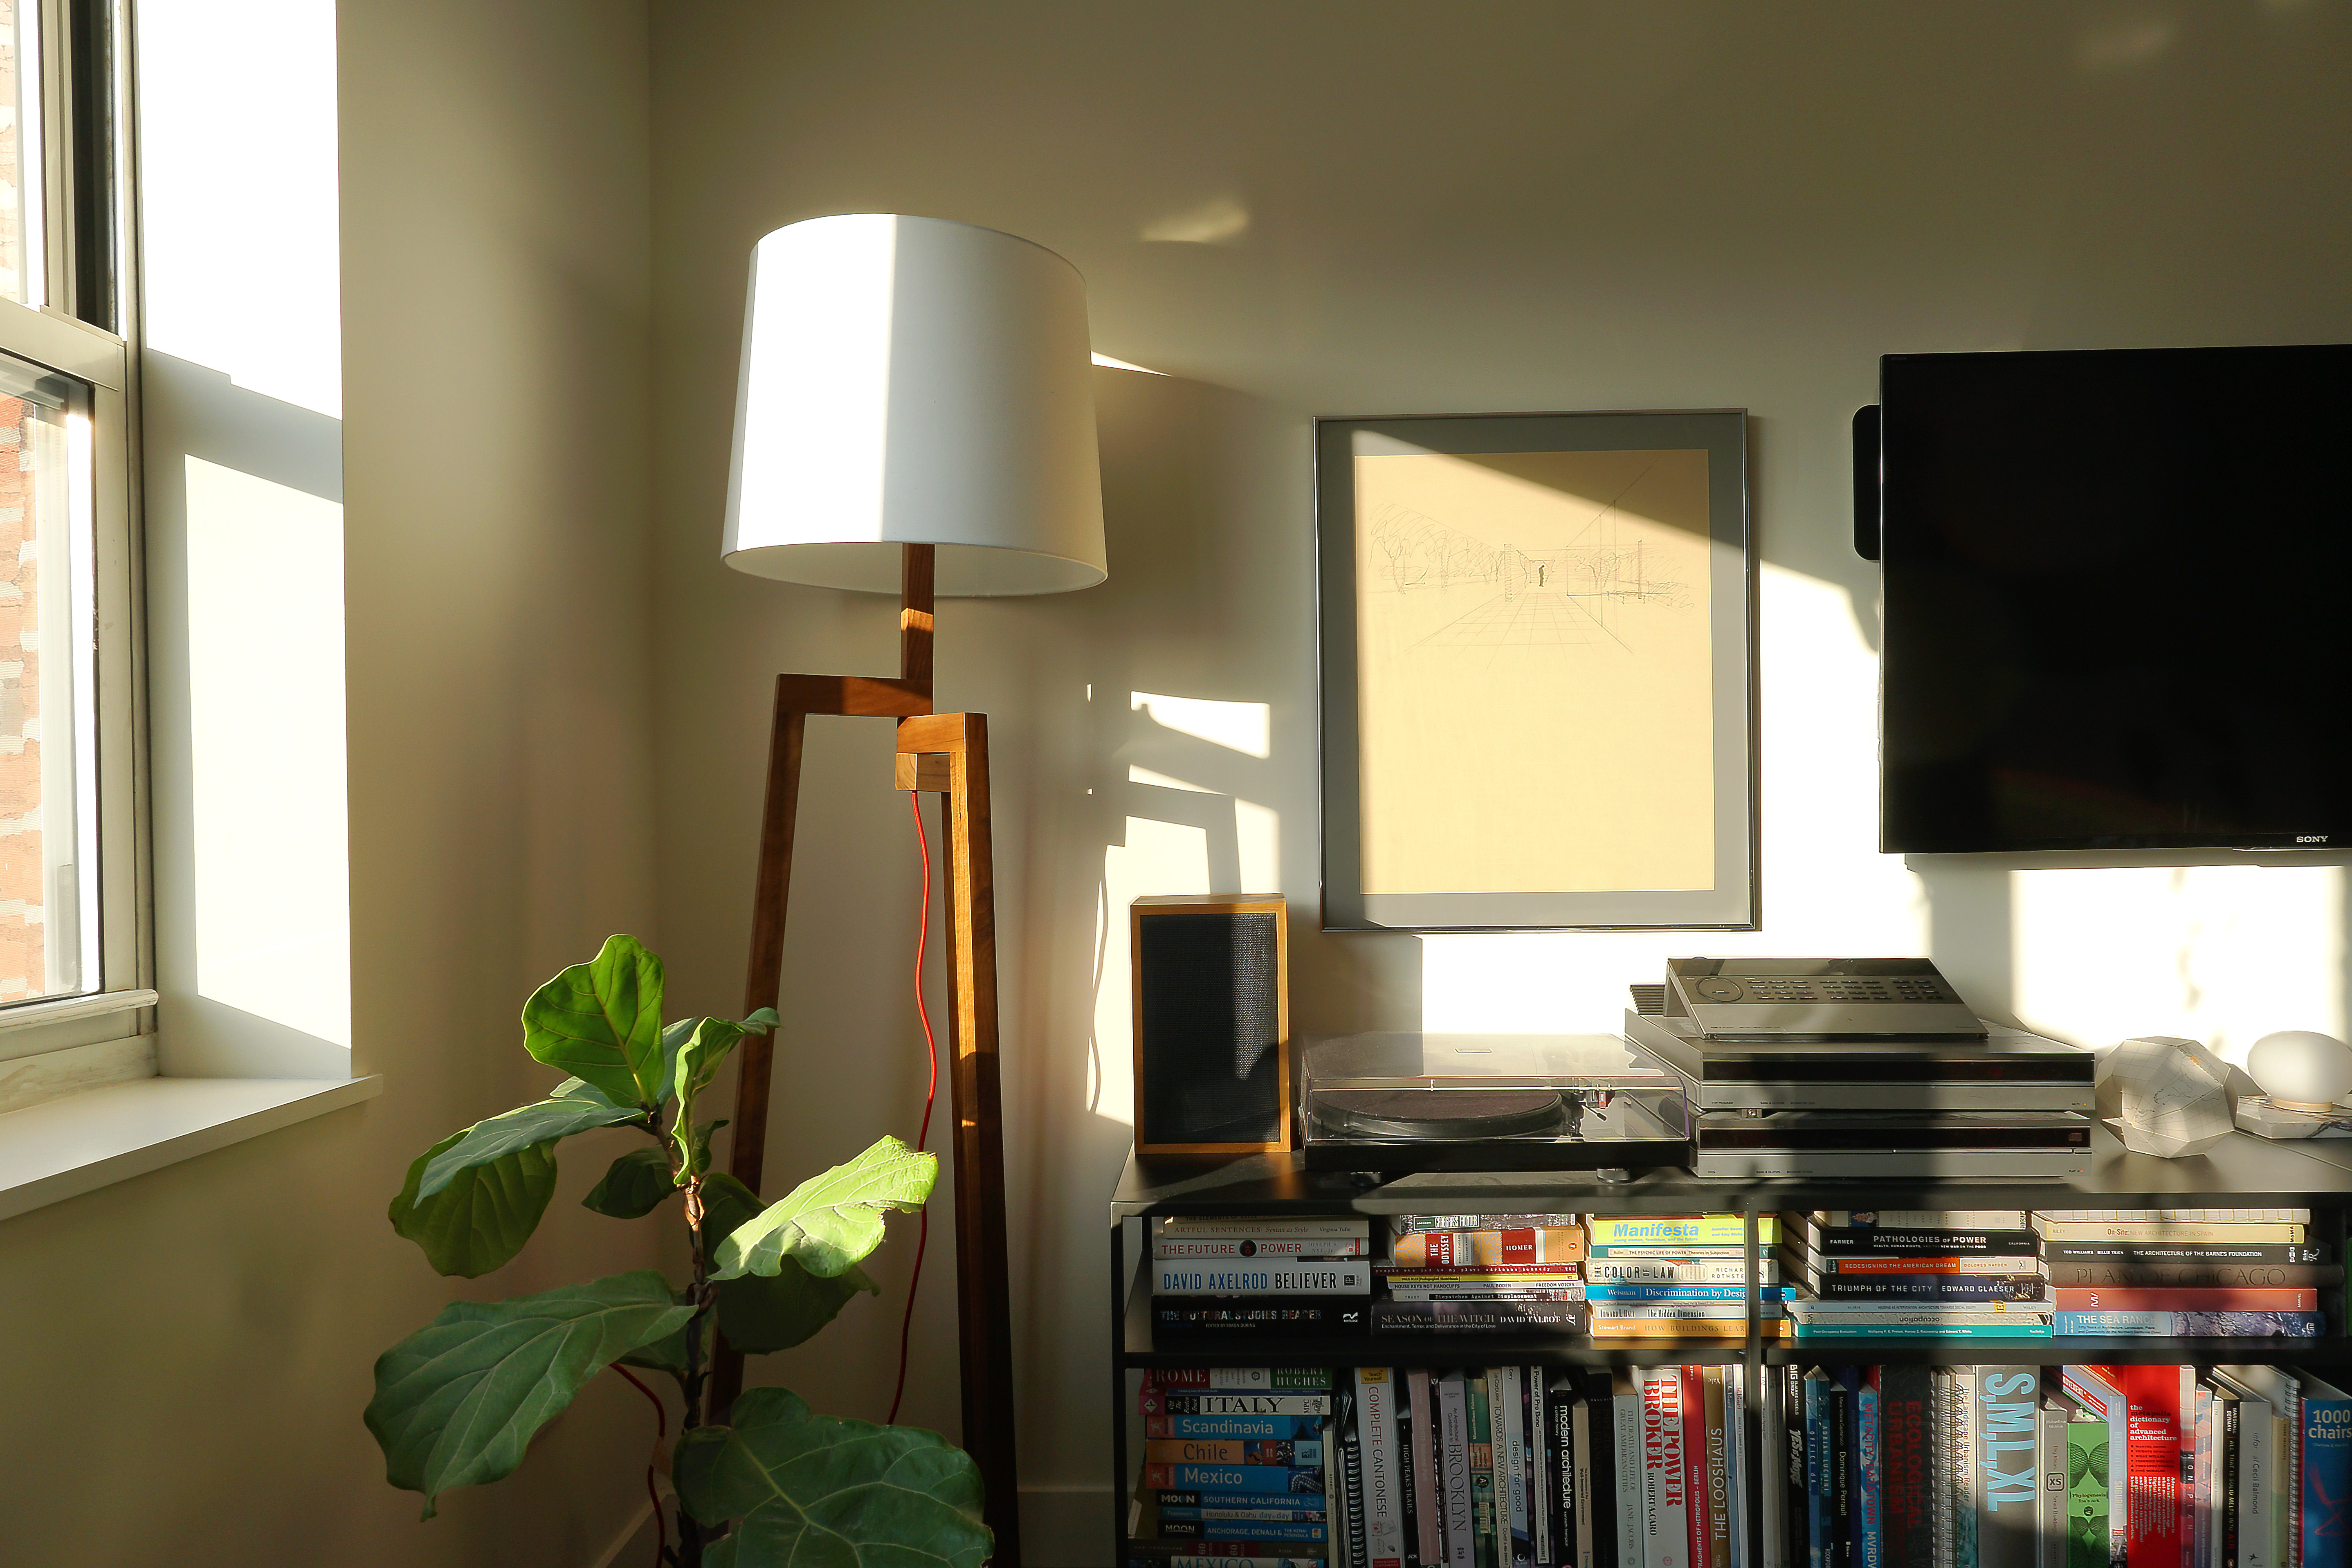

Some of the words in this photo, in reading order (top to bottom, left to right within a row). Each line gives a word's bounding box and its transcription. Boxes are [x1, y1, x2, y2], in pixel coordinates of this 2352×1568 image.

[1435, 1216, 1458, 1227] CRABGRASS
[1460, 1215, 1477, 1227] FRONTIER
[1613, 1223, 1699, 1237] Manifesta
[1162, 1245, 1184, 1254] THE
[1188, 1245, 1235, 1254] FUTURE
[1245, 1244, 1251, 1254] OF
[1261, 1243, 1302, 1253] POWER
[1430, 1243, 1438, 1256] THE
[1440, 1235, 1449, 1264] ODYSSEY
[1164, 1274, 1202, 1289] DAVID
[1209, 1273, 1267, 1289] AXELROD
[1275, 1272, 1337, 1289] BELIEVER
[1605, 1267, 1640, 1278] COLOR
[1653, 1267, 1674, 1278] LAW
[2178, 1268, 2285, 1285] CHICAGO
[1646, 1288, 1709, 1296] Discrimination
[1711, 1289, 1721, 1298] by
[1723, 1289, 1745, 1298] Desig
[1160, 1310, 1179, 1320] THE
[1183, 1310, 1233, 1320] CULTURAL
[1236, 1310, 1276, 1320] STUDIES
[1282, 1310, 1321, 1320] READER
[1647, 1309, 1657, 1317] The
[1658, 1309, 1676, 1317] Hidden
[1678, 1309, 1705, 1317] Dimension
[2076, 1315, 2097, 1323] THE
[2100, 1315, 2120, 1323] SEA
[1156, 1370, 1205, 1383] ROME
[1277, 1377, 1326, 1386] HUGHES
[1205, 1397, 1285, 1413] ITALY
[1661, 1375, 1679, 1426] THE
[1367, 1386, 1382, 1446] COMPLETE
[1494, 1406, 1503, 1442] TOWARDS
[1644, 1379, 1663, 1470] BROKER
[2313, 1409, 2350, 1423] 1000
[1182, 1419, 1273, 1434] Scandinavia
[1560, 1405, 1569, 1447] modern
[2309, 1424, 2352, 1439] chairs
[1184, 1443, 1228, 1460] Chile
[1511, 1440, 1519, 1471] design
[1887, 1402, 1904, 1514] URBANISM
[1663, 1429, 1684, 1507] POWER
[1712, 1428, 1725, 1507] LOOSHAUS
[1864, 1403, 1876, 1525] METACITY/DATATOWN
[1905, 1401, 1923, 1531] ECOLOGICAL
[1185, 1467, 1242, 1484] Mexico
[1373, 1449, 1387, 1517] CANTONESE
[1561, 1450, 1572, 1509] architecture
[1448, 1443, 1466, 1531] BROOKLYN
[1161, 1494, 1195, 1503] MOON
[1250, 1497, 1300, 1505] CALIFORNIA
[1498, 1470, 1508, 1525] ARCHITECTURE
[1513, 1488, 1523, 1512] good
[2114, 1480, 2123, 1515] SUBURBIA
[1260, 1512, 1271, 1520] day
[1277, 1512, 1289, 1521] day
[1207, 1528, 1249, 1536] ANCHORAGE,
[1696, 1527, 1702, 1536] OF
[1714, 1513, 1726, 1541] THE
[1867, 1531, 1877, 1568] MVRDV
